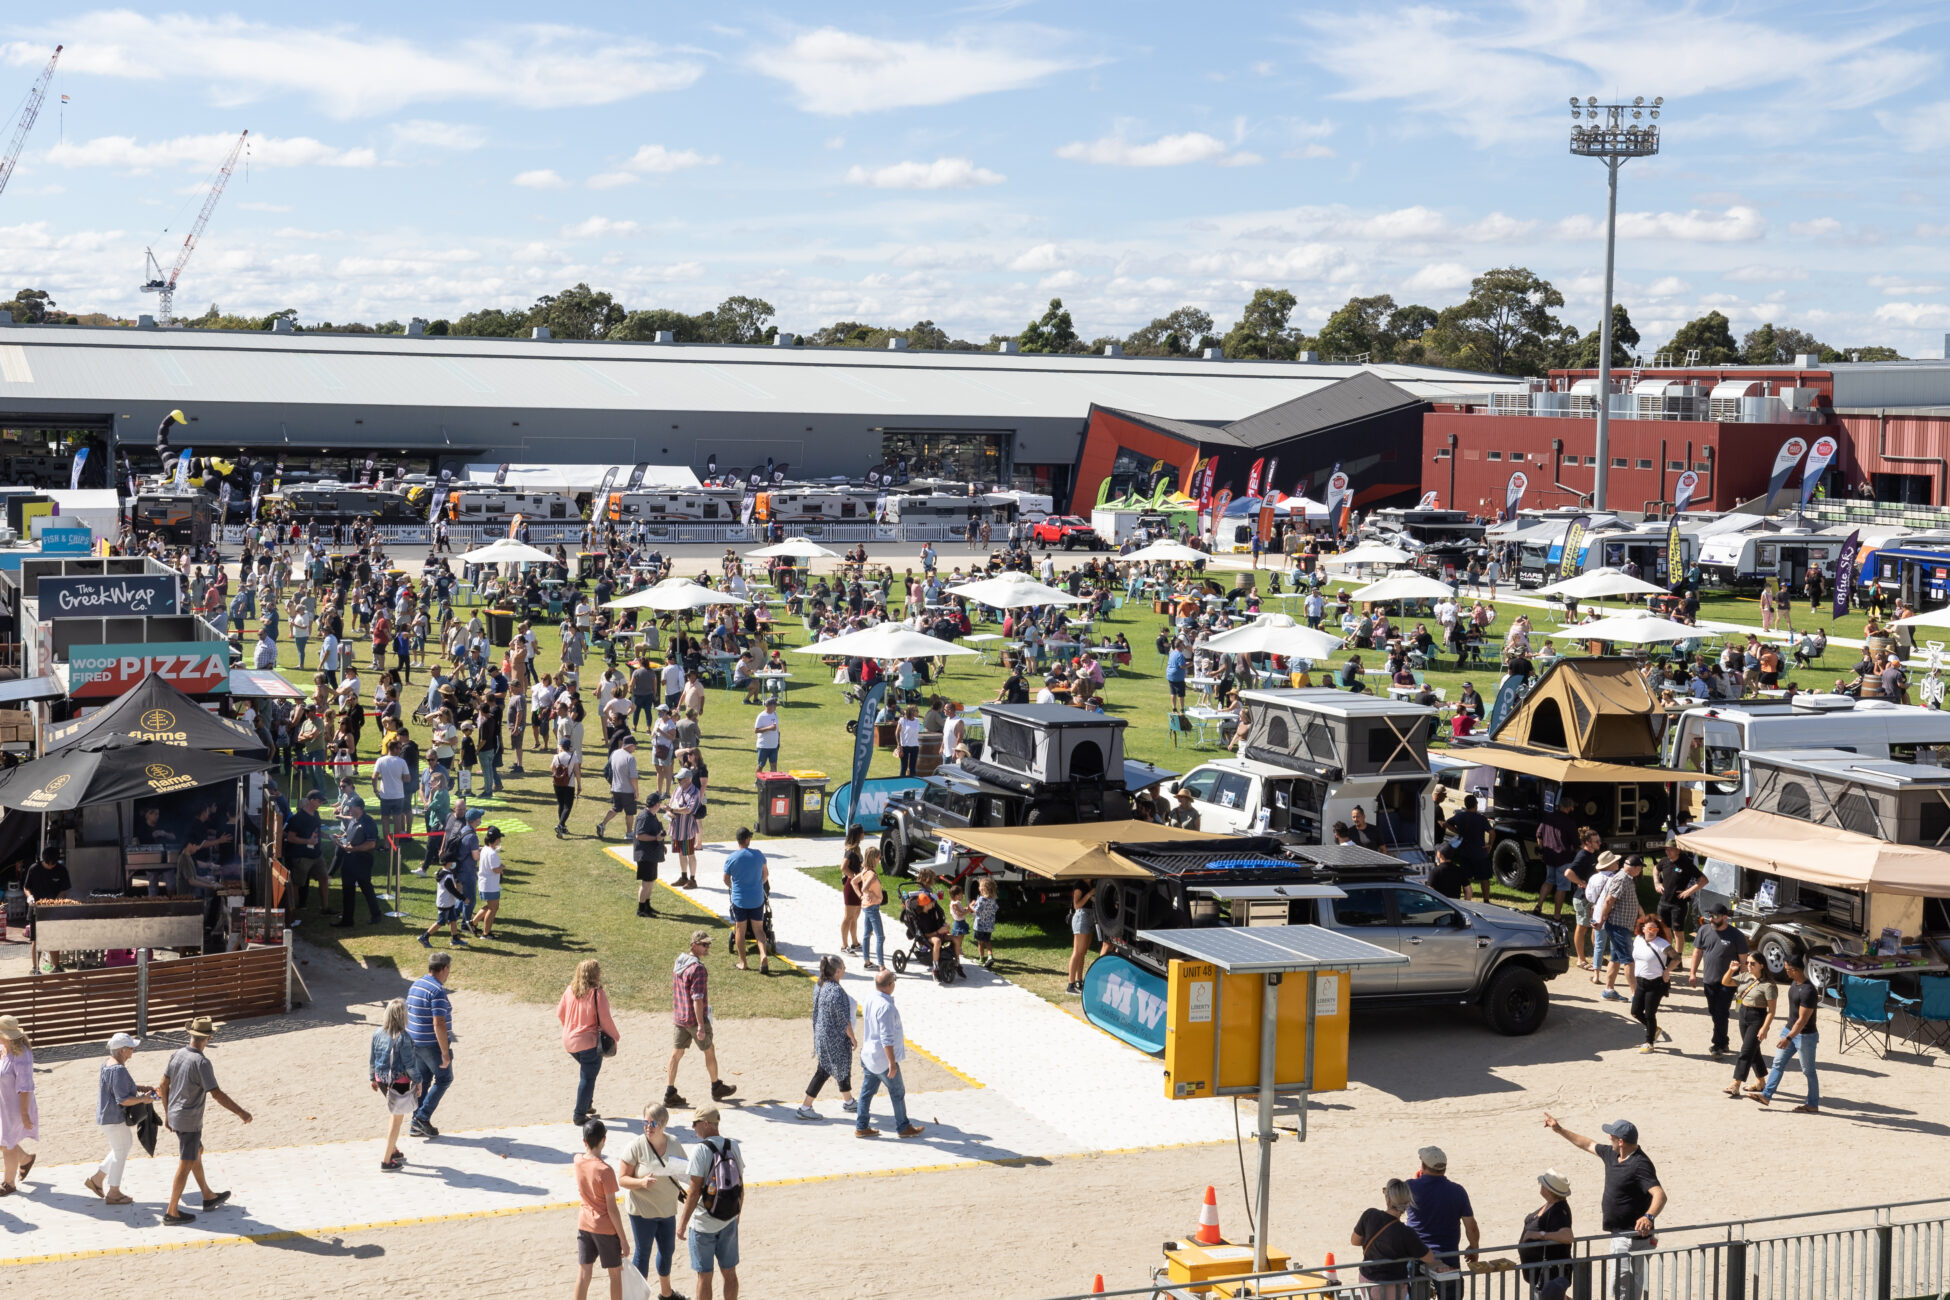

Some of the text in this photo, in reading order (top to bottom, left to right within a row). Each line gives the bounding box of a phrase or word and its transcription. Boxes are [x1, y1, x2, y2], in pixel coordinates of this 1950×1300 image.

[1201, 466, 1213, 504] MET
[43, 535, 59, 544] FISH
[68, 534, 89, 545] CHIPS
[76, 584, 95, 594] The
[1836, 575, 1848, 605] Blue
[130, 601, 148, 611] Co.
[72, 658, 116, 669] WOOD
[120, 653, 228, 681] PIZZA
[72, 671, 112, 683] FIRED
[128, 730, 187, 741] flame
[148, 774, 192, 791] flame
[156, 780, 198, 793] skewers
[1183, 965, 1213, 978] UNIT 48
